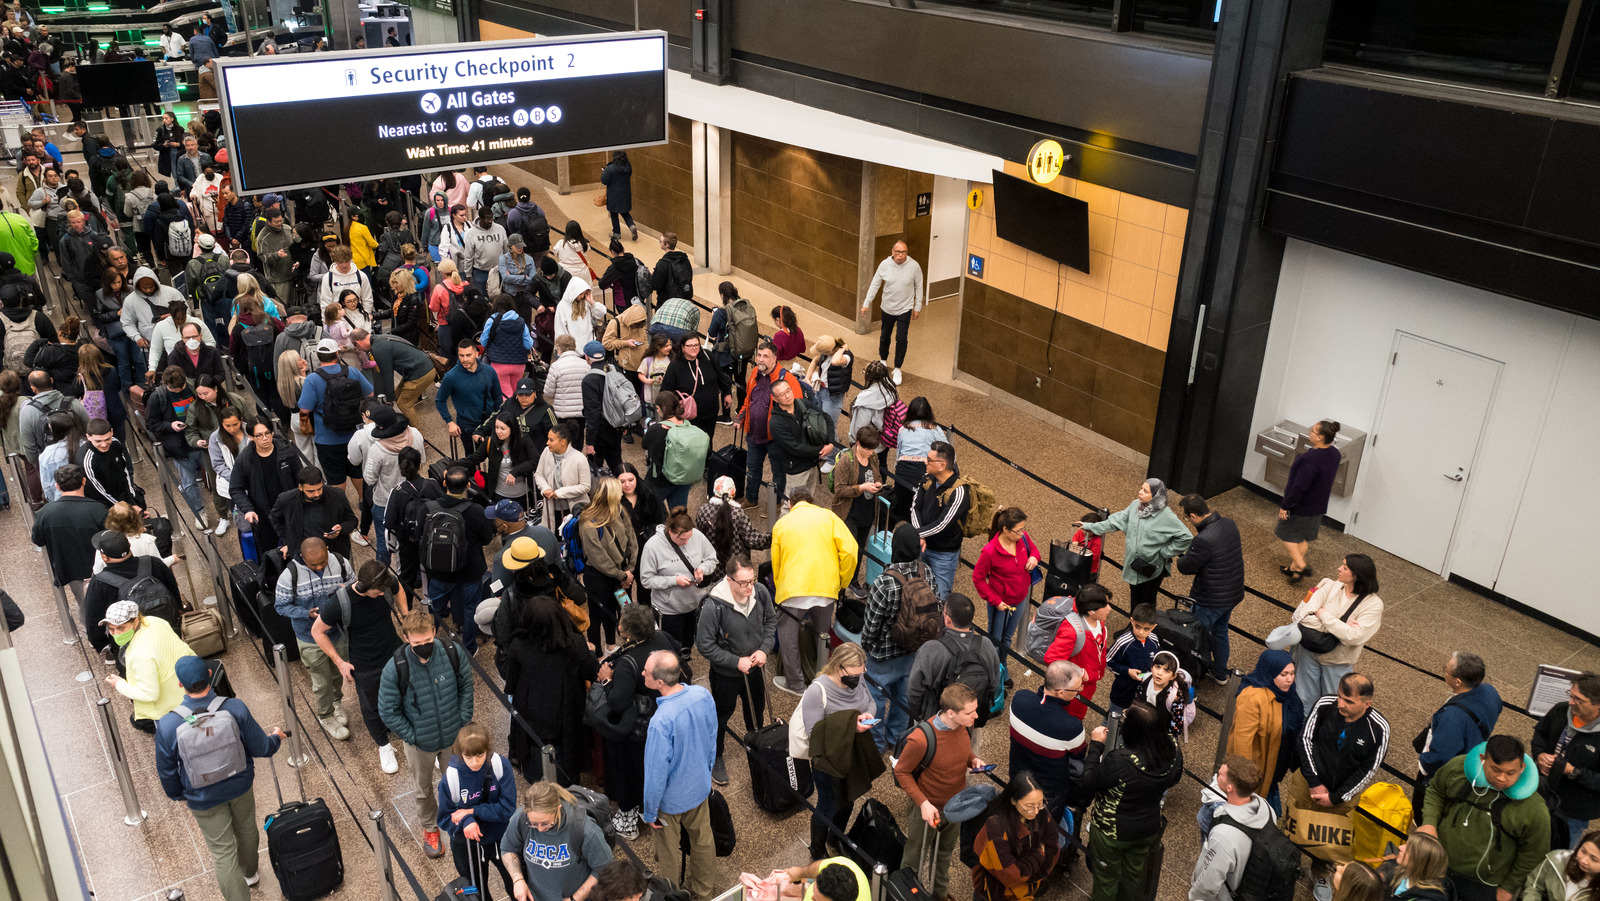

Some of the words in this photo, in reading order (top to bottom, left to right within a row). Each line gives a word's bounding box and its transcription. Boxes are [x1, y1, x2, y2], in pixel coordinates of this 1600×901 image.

[370, 63, 448, 84] Security
[455, 55, 554, 78] Checkpoint
[567, 53, 575, 68] 2
[446, 91, 468, 109] All
[471, 91, 516, 107] Gates
[378, 123, 428, 138] Nearest
[431, 121, 448, 134] to:
[476, 115, 510, 128] Gates
[517, 112, 525, 123] A
[534, 110, 541, 121] B
[551, 109, 557, 120] S
[406, 146, 435, 159] Wait
[437, 144, 470, 156] Time:
[471, 140, 485, 152] 41
[489, 136, 534, 150] minutes
[1307, 823, 1352, 846] NIKE
[526, 839, 570, 861] DECA
